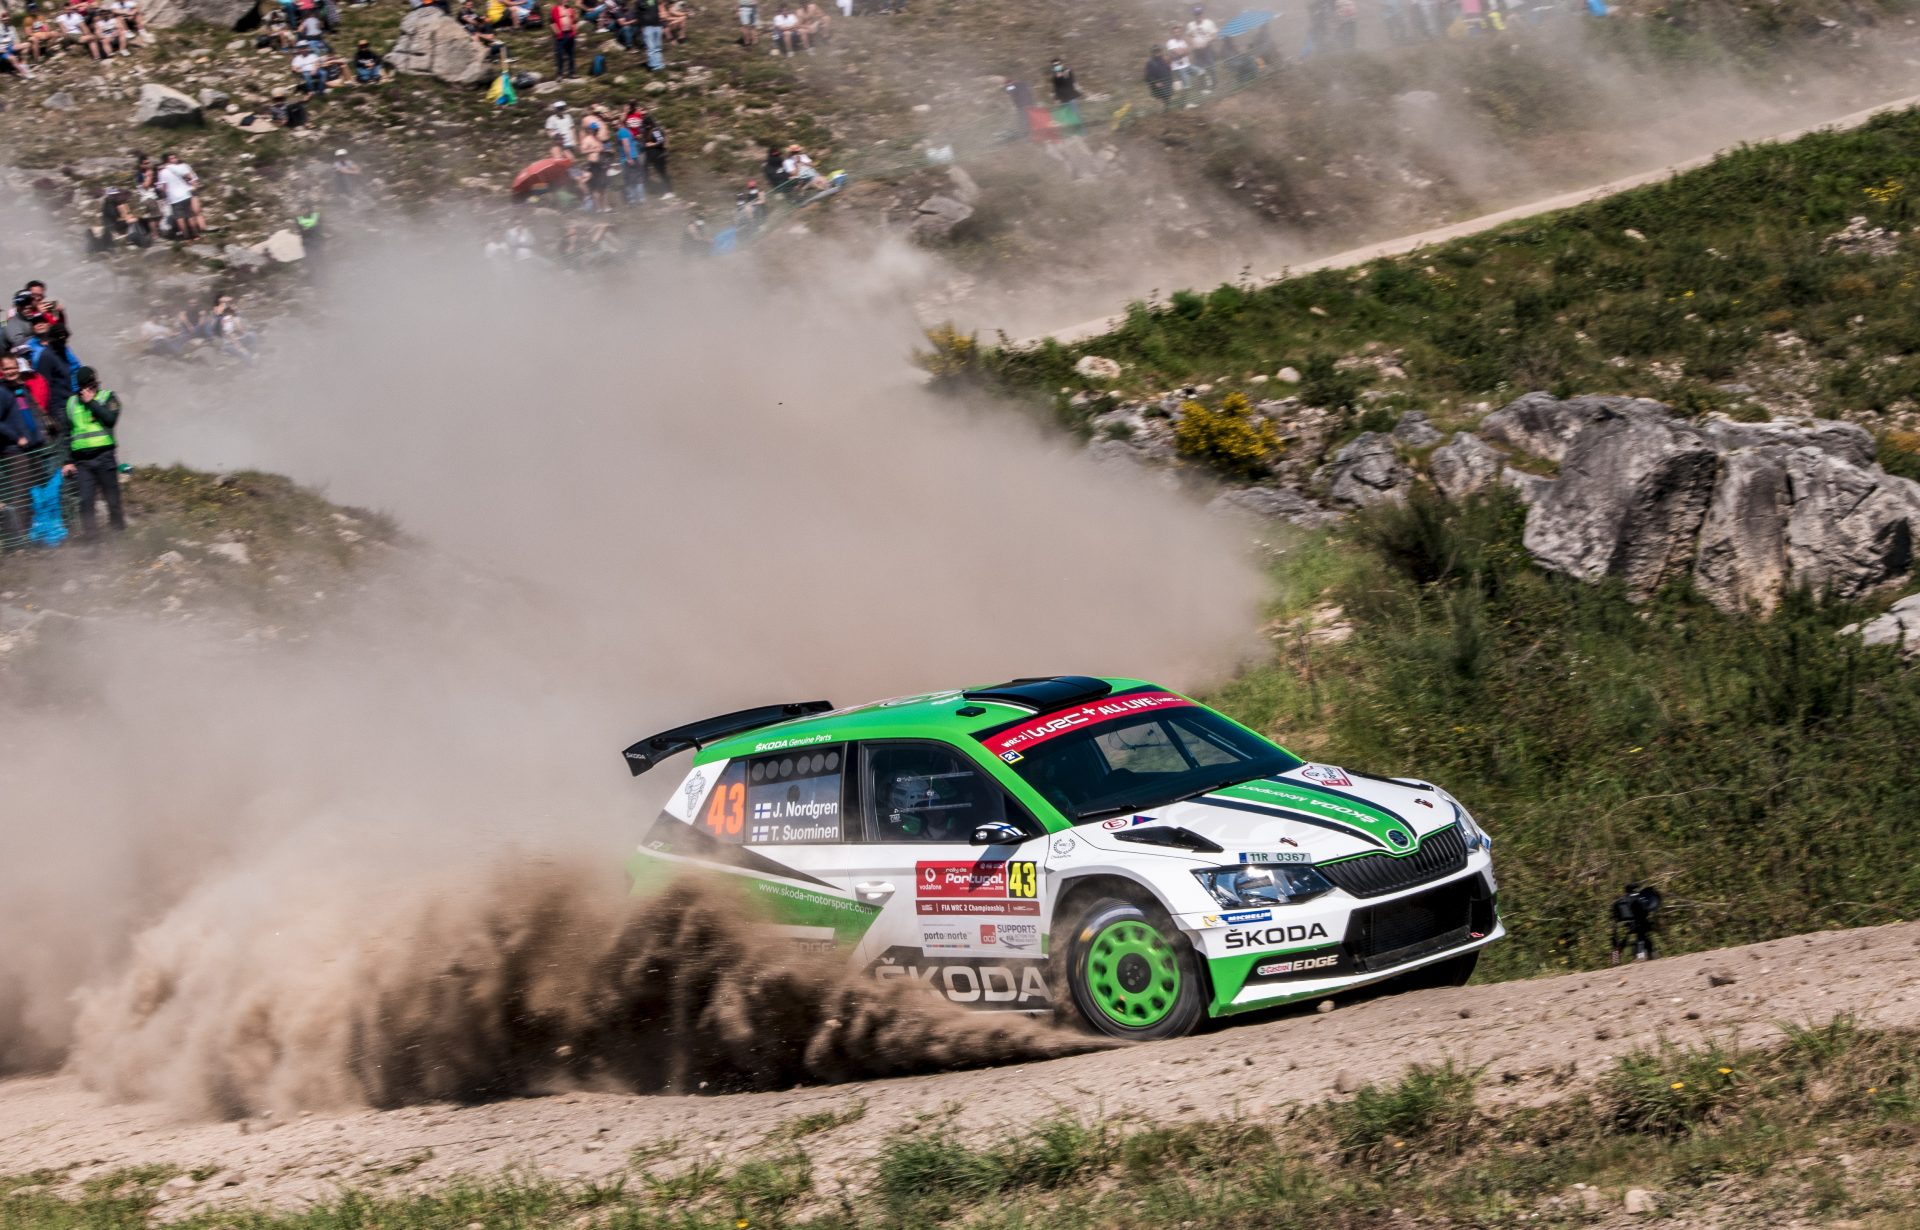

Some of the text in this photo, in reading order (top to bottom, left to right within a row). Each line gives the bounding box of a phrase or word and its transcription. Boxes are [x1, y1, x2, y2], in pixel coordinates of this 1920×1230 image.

[1098, 704, 1124, 716] ALL
[1126, 697, 1156, 710] LIVE
[755, 734, 832, 752] ŠKODA Genuine Parts
[1001, 737, 1018, 748] WRC
[707, 782, 746, 835] 43
[772, 800, 838, 819] J. Nordgren
[770, 823, 839, 841] T. Suominen
[1250, 853, 1306, 861] 11R 0367
[945, 873, 1004, 886] Portugal
[1009, 862, 1036, 897] 43
[758, 883, 873, 915] www.skoda-motorsport.com
[968, 904, 1005, 912] Championship
[1227, 912, 1271, 922] MICHELIN
[997, 925, 1036, 934] SUPPORTS
[1224, 922, 1329, 950] ŠKODA
[1266, 954, 1340, 974] Castrol EDGE
